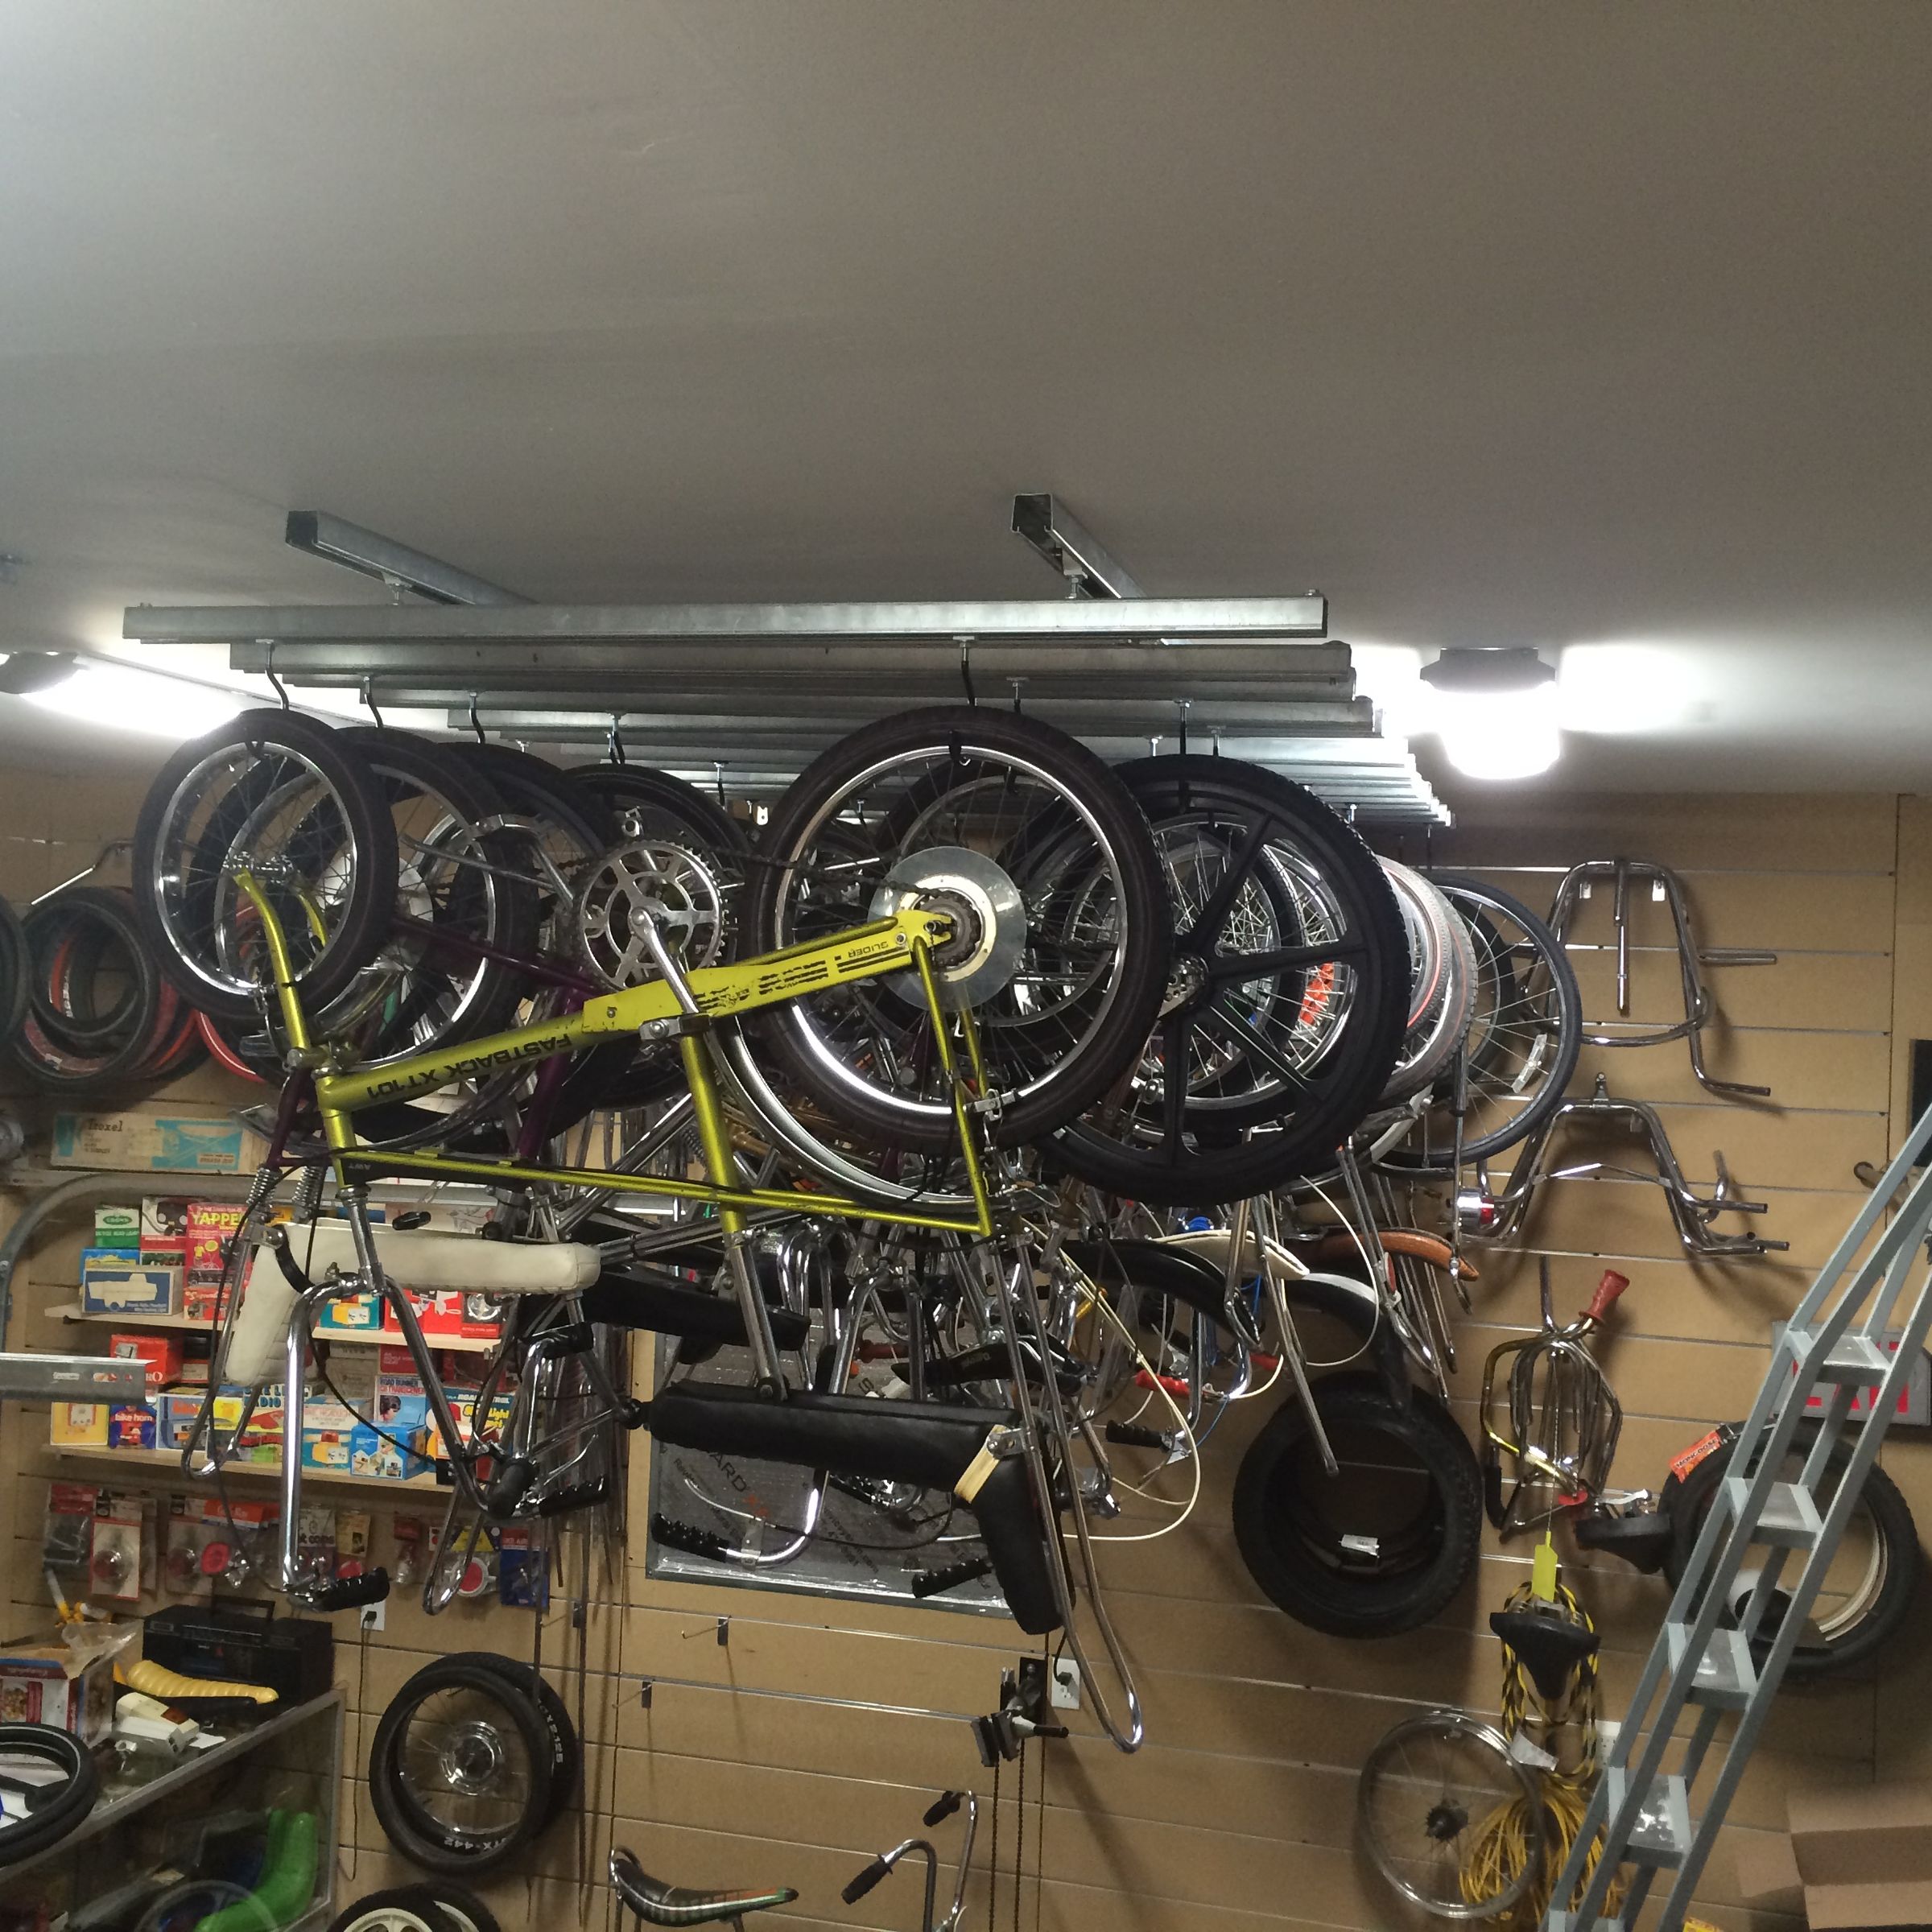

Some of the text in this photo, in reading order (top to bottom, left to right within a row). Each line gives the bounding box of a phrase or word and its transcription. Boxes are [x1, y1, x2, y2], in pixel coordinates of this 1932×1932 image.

[848, 941, 889, 958] SLIDER
[366, 1033, 572, 1100] FASTBACK XT101
[192, 1211, 246, 1226] YAPPE
